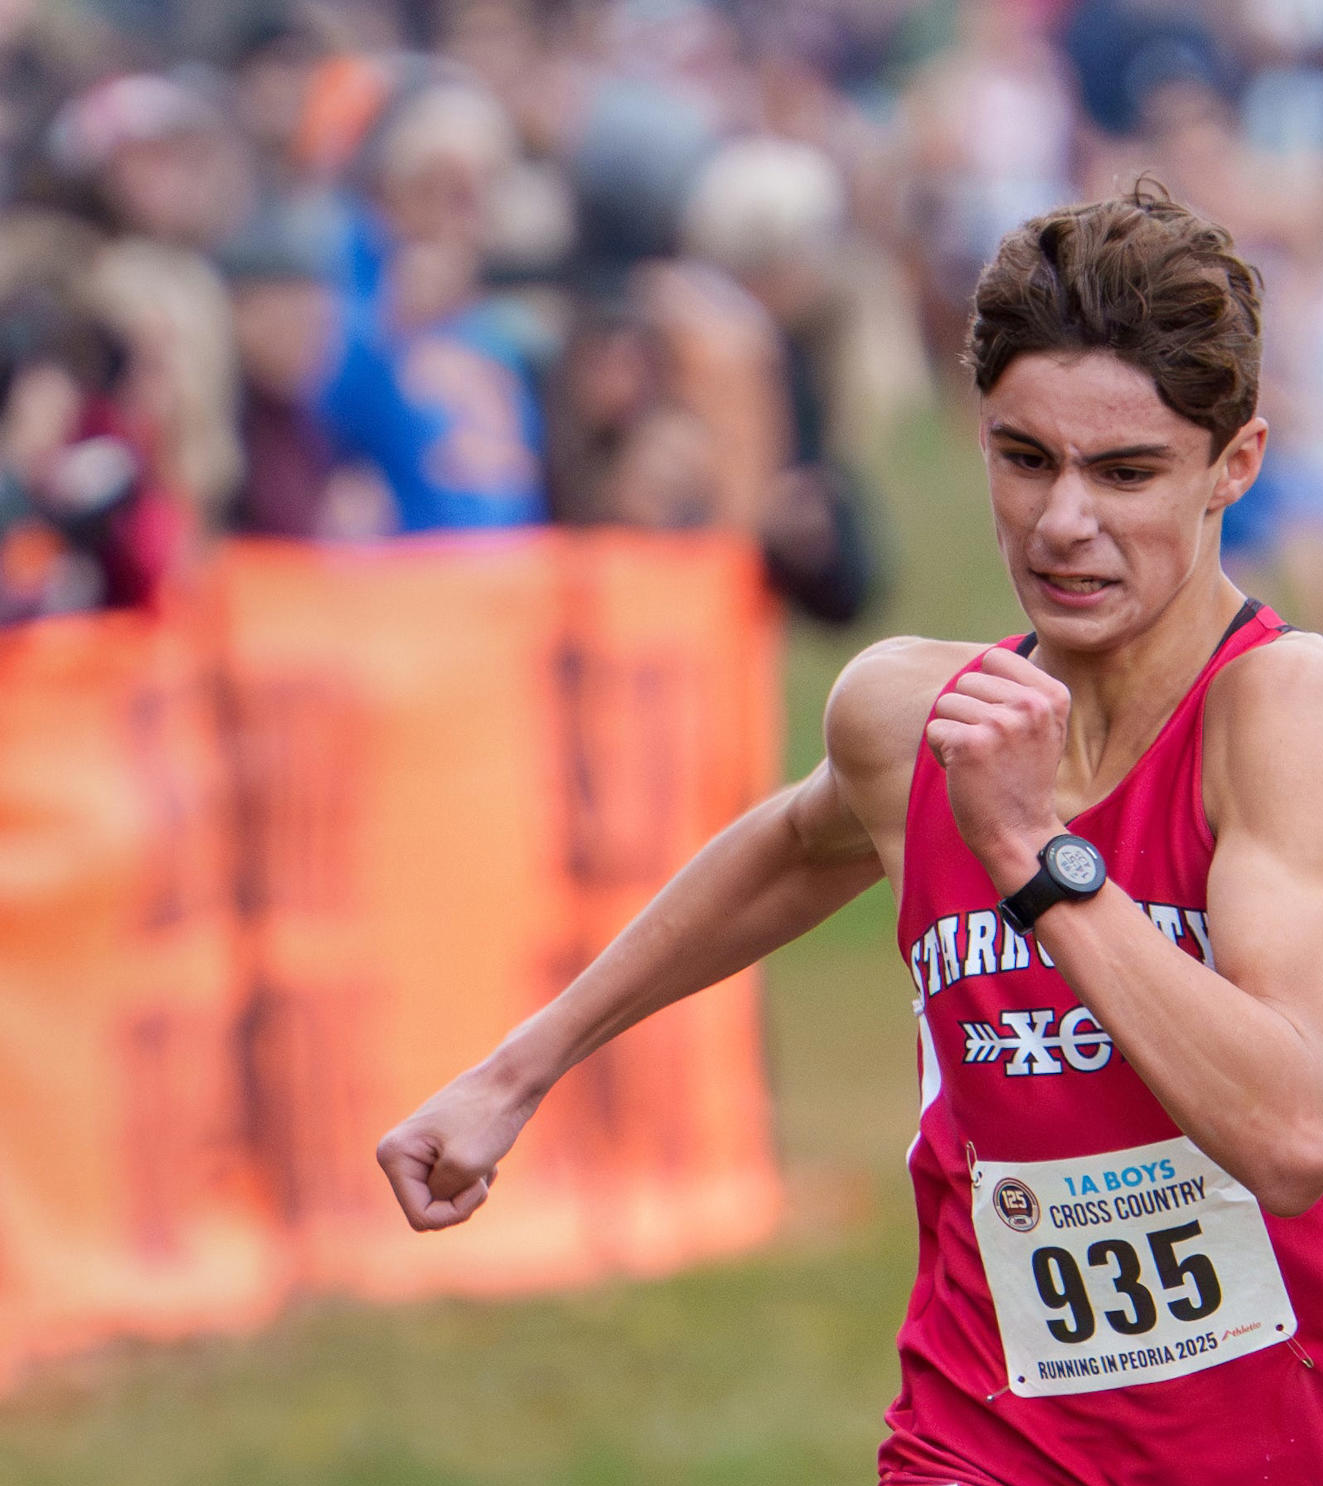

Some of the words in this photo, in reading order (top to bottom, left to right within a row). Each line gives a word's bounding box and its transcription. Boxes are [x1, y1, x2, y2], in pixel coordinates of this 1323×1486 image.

[1001, 1189, 1029, 1209] 125
[1049, 1199, 1113, 1230] CROSS
[1113, 1175, 1207, 1221] COUNTRY
[1063, 1174, 1100, 1197] 1A
[1103, 1158, 1177, 1192] BOYS
[1030, 1219, 1223, 1345] 935
[1037, 1356, 1101, 1381] RUNNING
[1100, 1354, 1117, 1375] IN
[1120, 1345, 1177, 1371] PEORIA
[1175, 1331, 1219, 1360] 2025
